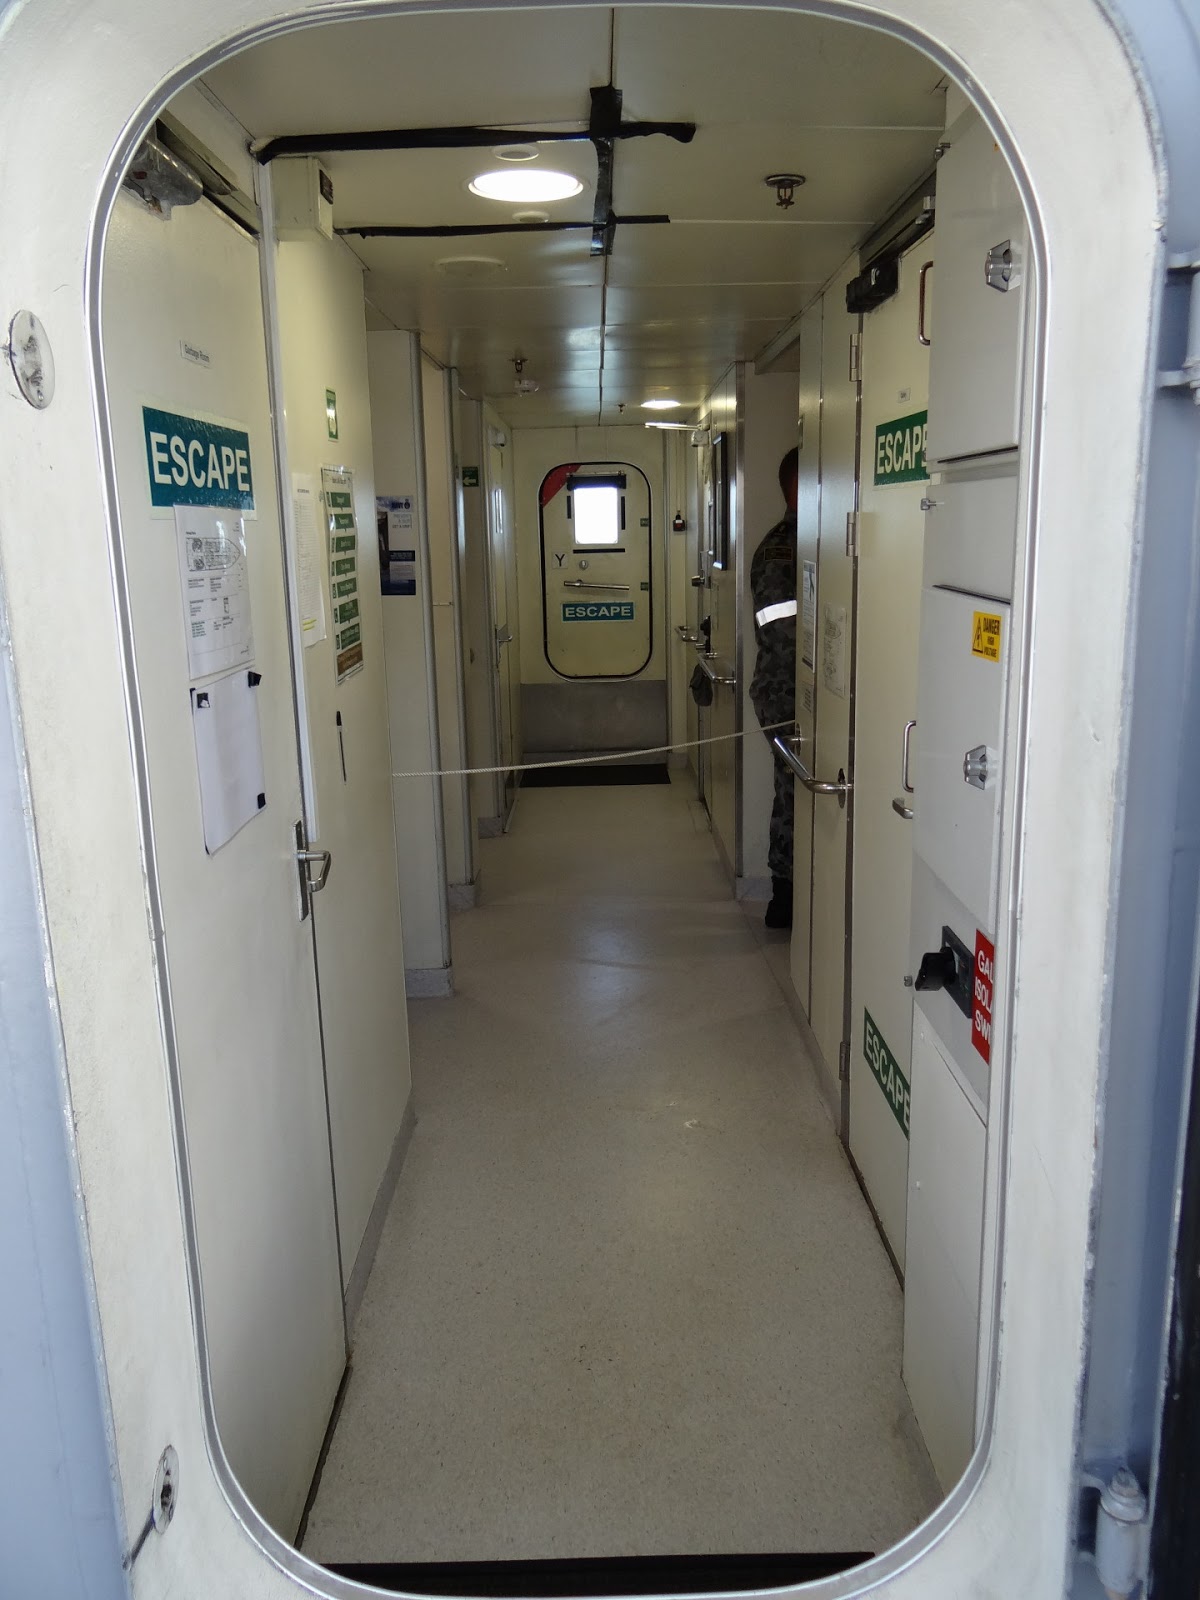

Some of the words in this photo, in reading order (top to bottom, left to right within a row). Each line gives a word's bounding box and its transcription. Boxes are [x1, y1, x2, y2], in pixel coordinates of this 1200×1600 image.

[149, 431, 250, 492] ESCAPE
[877, 423, 928, 474] ESCAPE
[554, 553, 566, 567] Y
[565, 605, 631, 618] ESCAPE
[983, 617, 1000, 636] DANGER
[974, 976, 992, 1014] ISOL
[865, 1020, 910, 1131] ESCAPE
